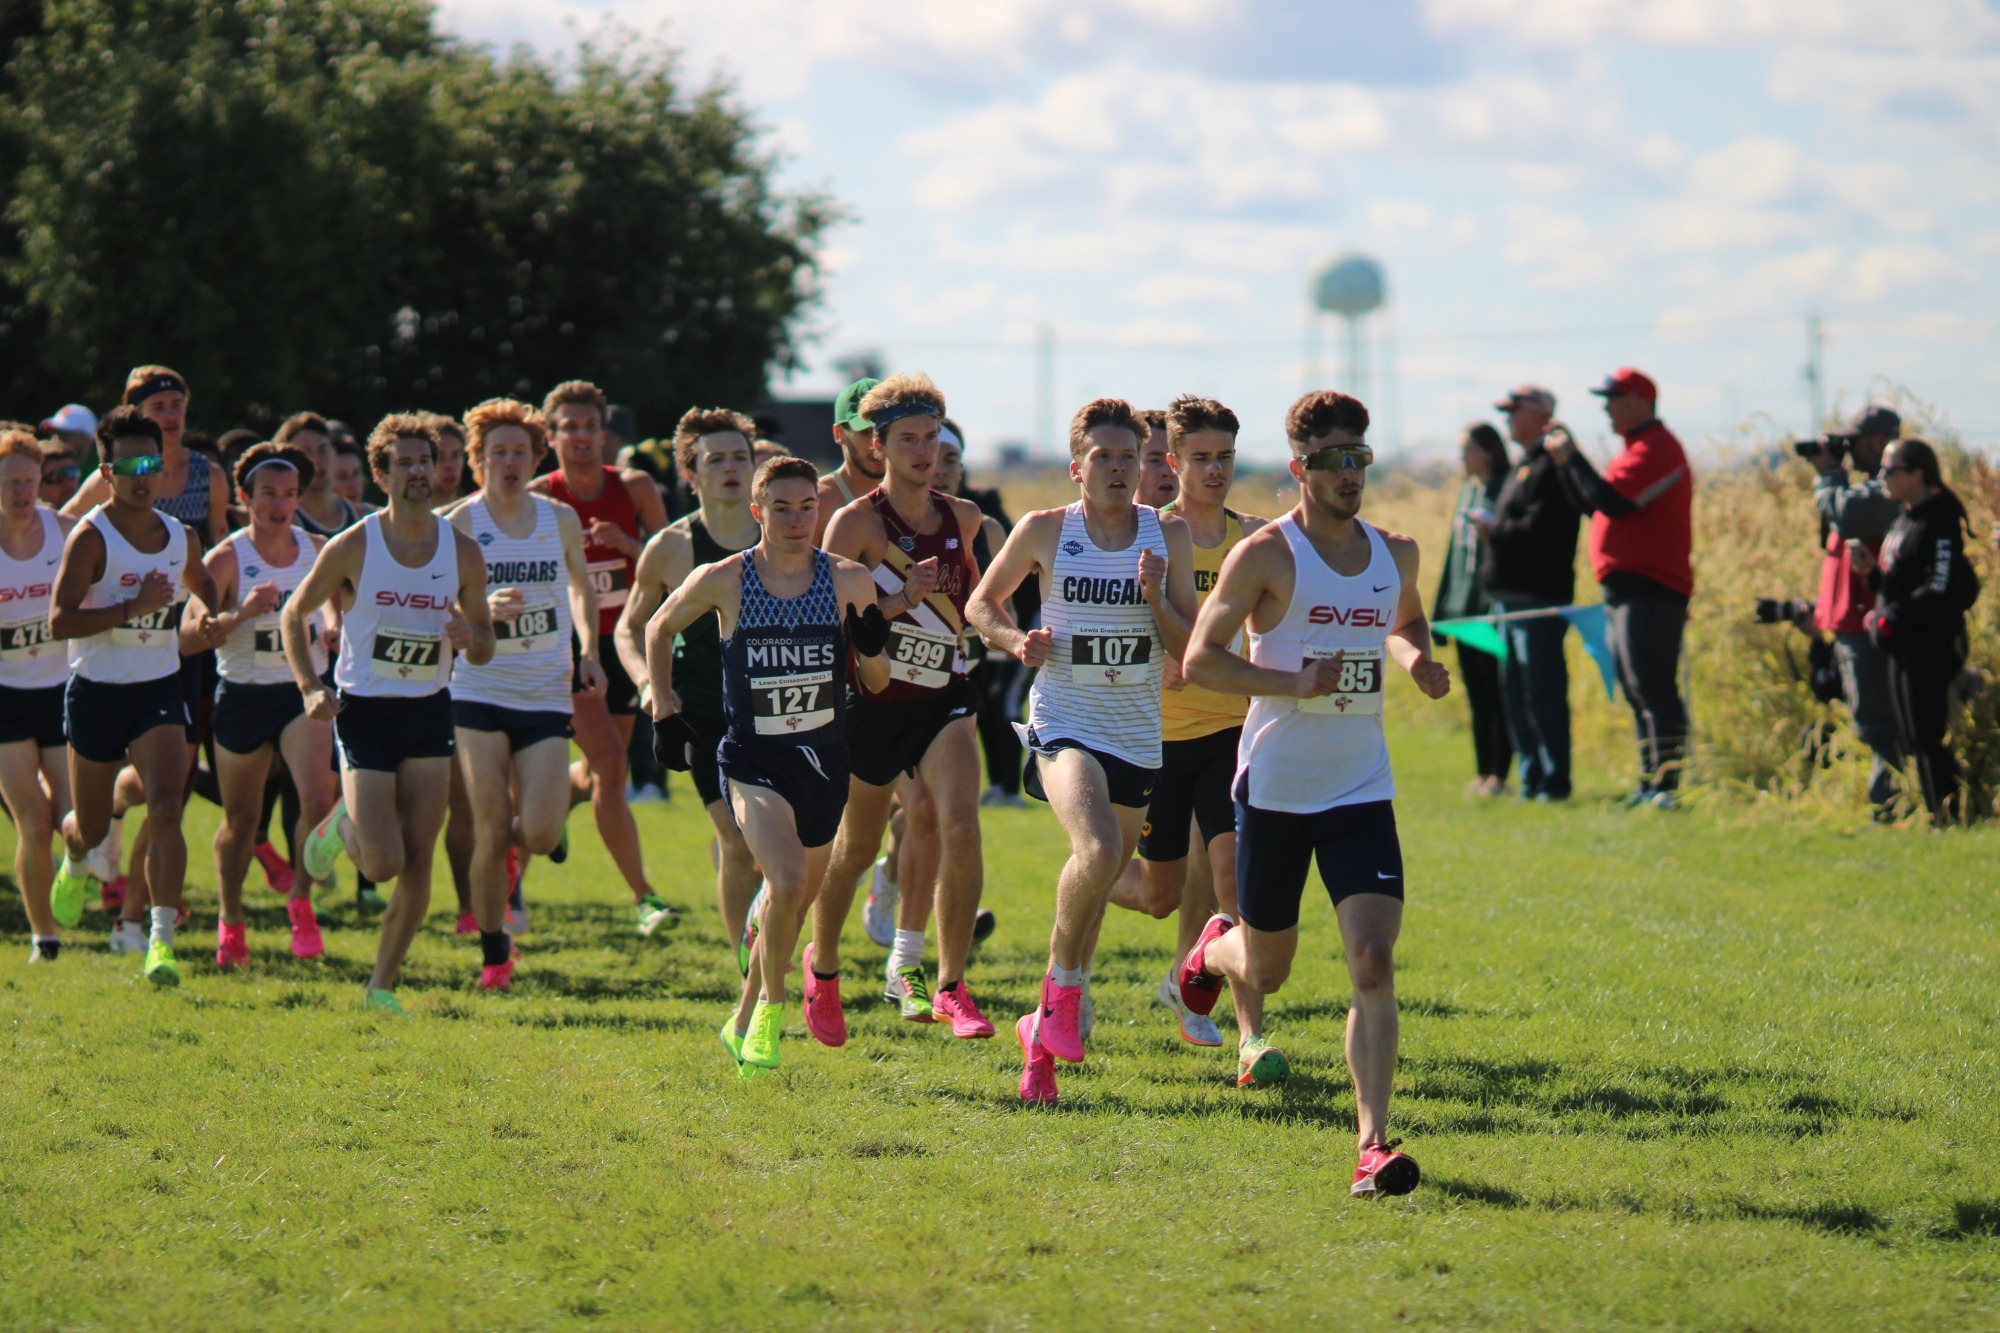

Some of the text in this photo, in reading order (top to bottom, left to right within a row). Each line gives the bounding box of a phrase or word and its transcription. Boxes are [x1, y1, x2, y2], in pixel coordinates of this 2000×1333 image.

[375, 590, 448, 610] SVSU
[1063, 576, 1148, 605] COUGA
[506, 611, 549, 638] 108
[1308, 605, 1391, 627] SVSU
[11, 620, 52, 646] 478
[746, 638, 793, 646] COLORADO
[385, 639, 434, 665] 477
[747, 643, 835, 668] MINES
[896, 636, 946, 669] 599
[1087, 637, 1139, 665] 107
[1337, 661, 1374, 692] 85
[767, 685, 819, 715] 127
